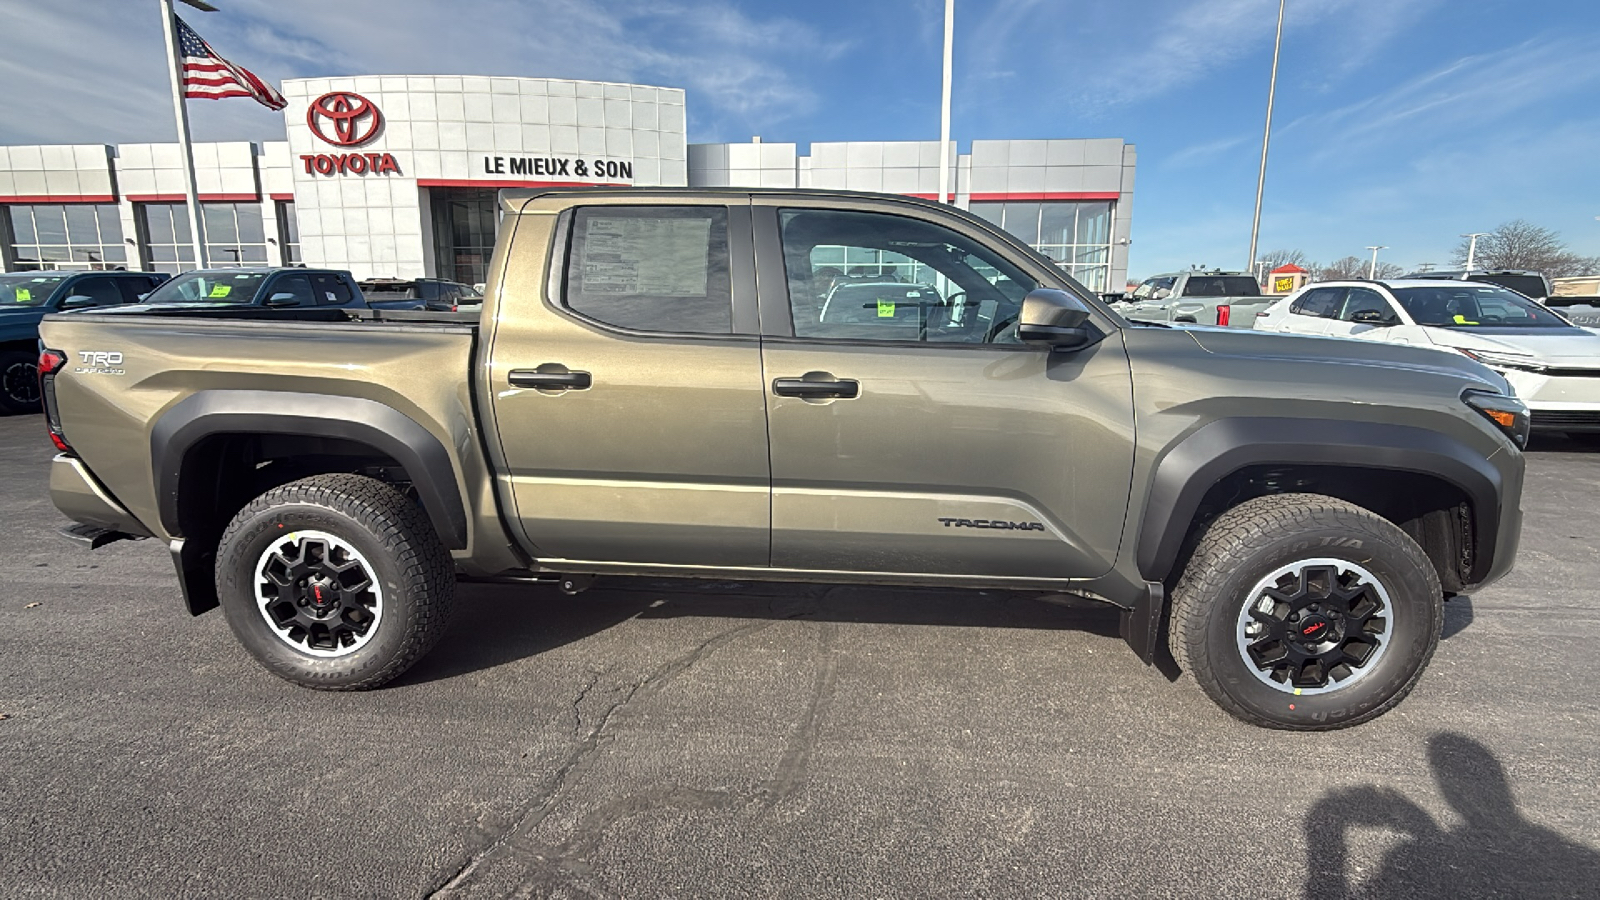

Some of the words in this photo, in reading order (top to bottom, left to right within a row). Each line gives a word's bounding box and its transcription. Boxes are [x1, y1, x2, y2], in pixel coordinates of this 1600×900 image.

[299, 153, 398, 174] TOYOTA
[484, 156, 505, 174] LE
[509, 157, 570, 176] MIEUX
[574, 159, 589, 177] &
[594, 160, 633, 178] SON
[78, 351, 123, 367] TRD
[938, 517, 1045, 531] TACOMA
